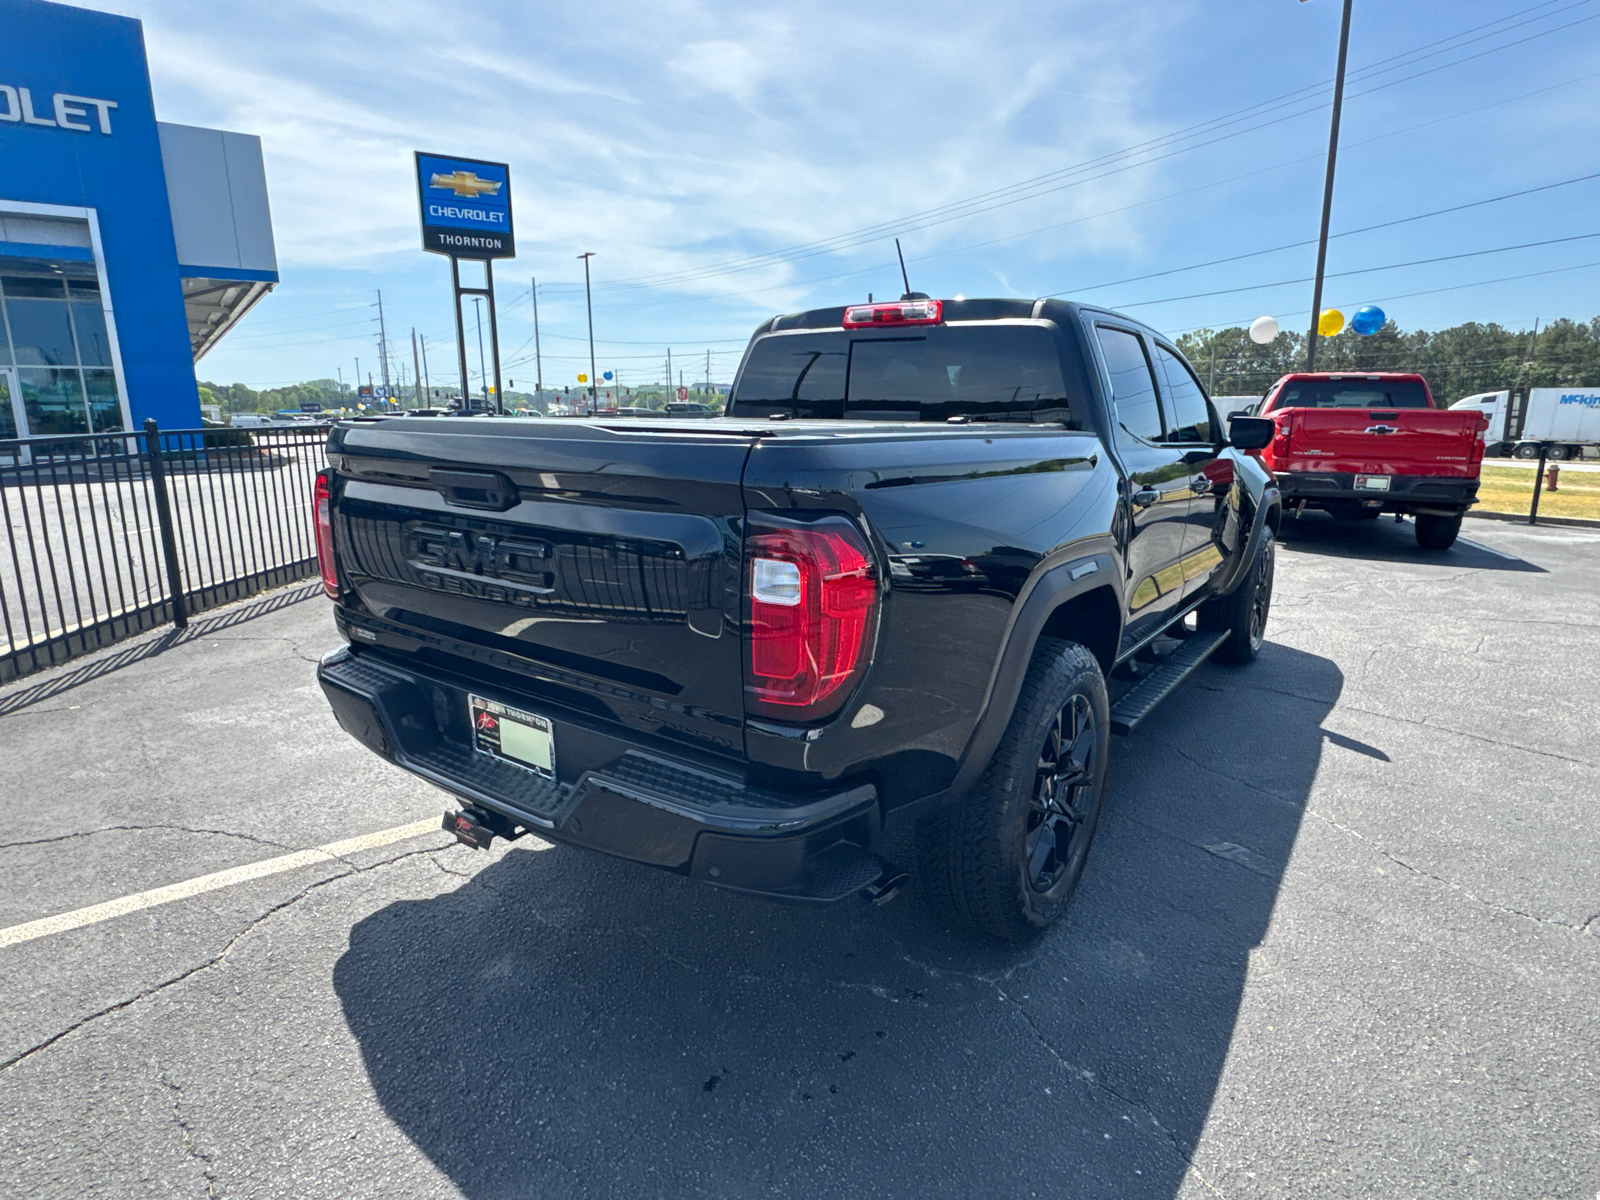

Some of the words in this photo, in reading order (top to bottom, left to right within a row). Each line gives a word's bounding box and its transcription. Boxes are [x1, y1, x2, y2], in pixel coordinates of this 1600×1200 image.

[429, 205, 504, 223] CHEVROLET
[439, 234, 502, 249] THORNTON
[406, 526, 555, 589] GMC
[422, 571, 538, 609] DENALI
[486, 701, 506, 715] JOHN
[506, 708, 547, 729] THORNTON
